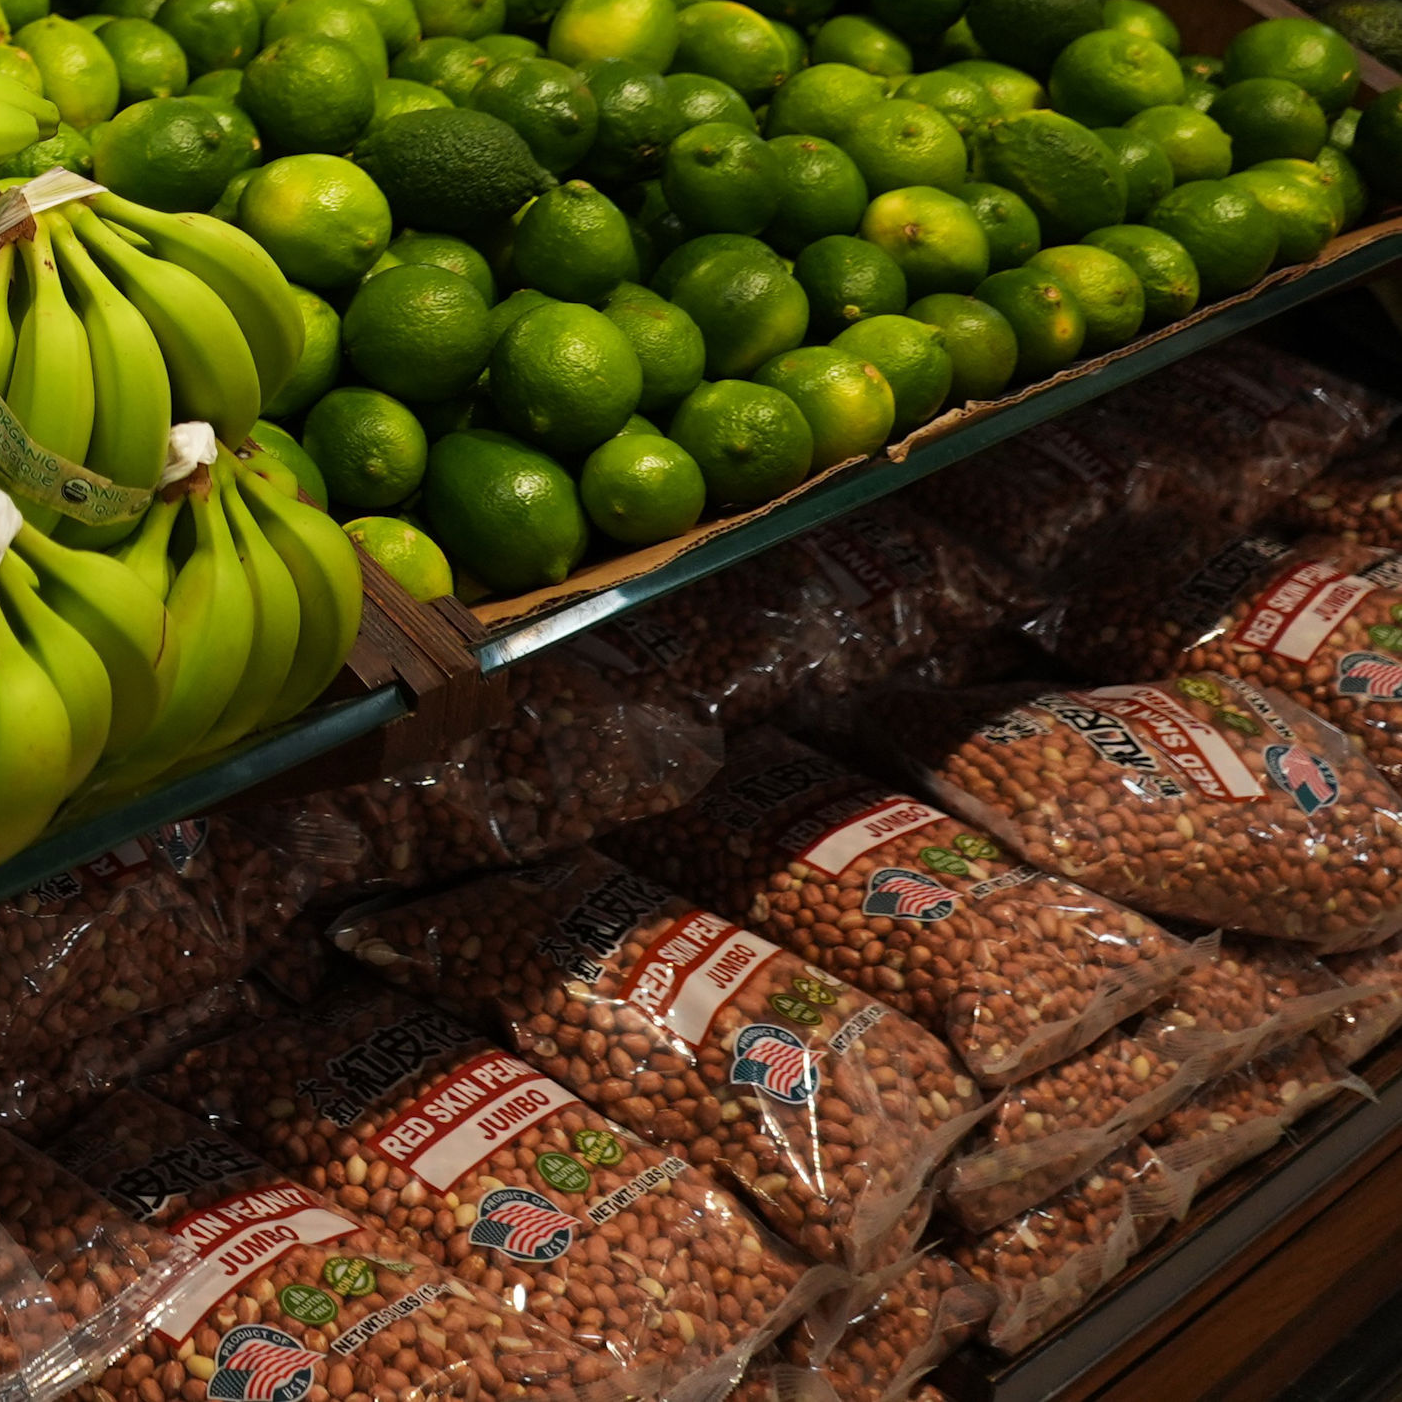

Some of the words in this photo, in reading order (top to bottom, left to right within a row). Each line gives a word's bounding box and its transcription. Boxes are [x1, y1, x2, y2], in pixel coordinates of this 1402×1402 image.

[1241, 608, 1284, 647] RED
[864, 805, 930, 838] JUMBO
[627, 960, 676, 1016] RED
[656, 934, 703, 968] SKIN
[705, 942, 757, 990] JUMBO
[738, 1027, 776, 1050] PRODUCT
[778, 1031, 795, 1044] OF
[378, 1115, 436, 1162] RED
[423, 1076, 488, 1124] SKIN
[476, 1088, 551, 1141] JUMBO
[483, 1191, 528, 1213] PRODUCT
[530, 1196, 549, 1210] OF
[588, 1201, 616, 1223] NET
[641, 1168, 665, 1190] LBS
[176, 1211, 233, 1260] KIN
[225, 1186, 311, 1225] PEANUT
[217, 1224, 300, 1277] JUMBO
[542, 1237, 568, 1257] USA
[294, 1293, 327, 1317] GLUTEN
[309, 1303, 333, 1319] FREE
[333, 1329, 361, 1355] NET
[393, 1294, 421, 1316] LBS
[220, 1328, 274, 1357] PRODUCT
[273, 1332, 293, 1349] OF
[282, 1371, 309, 1401] USA
